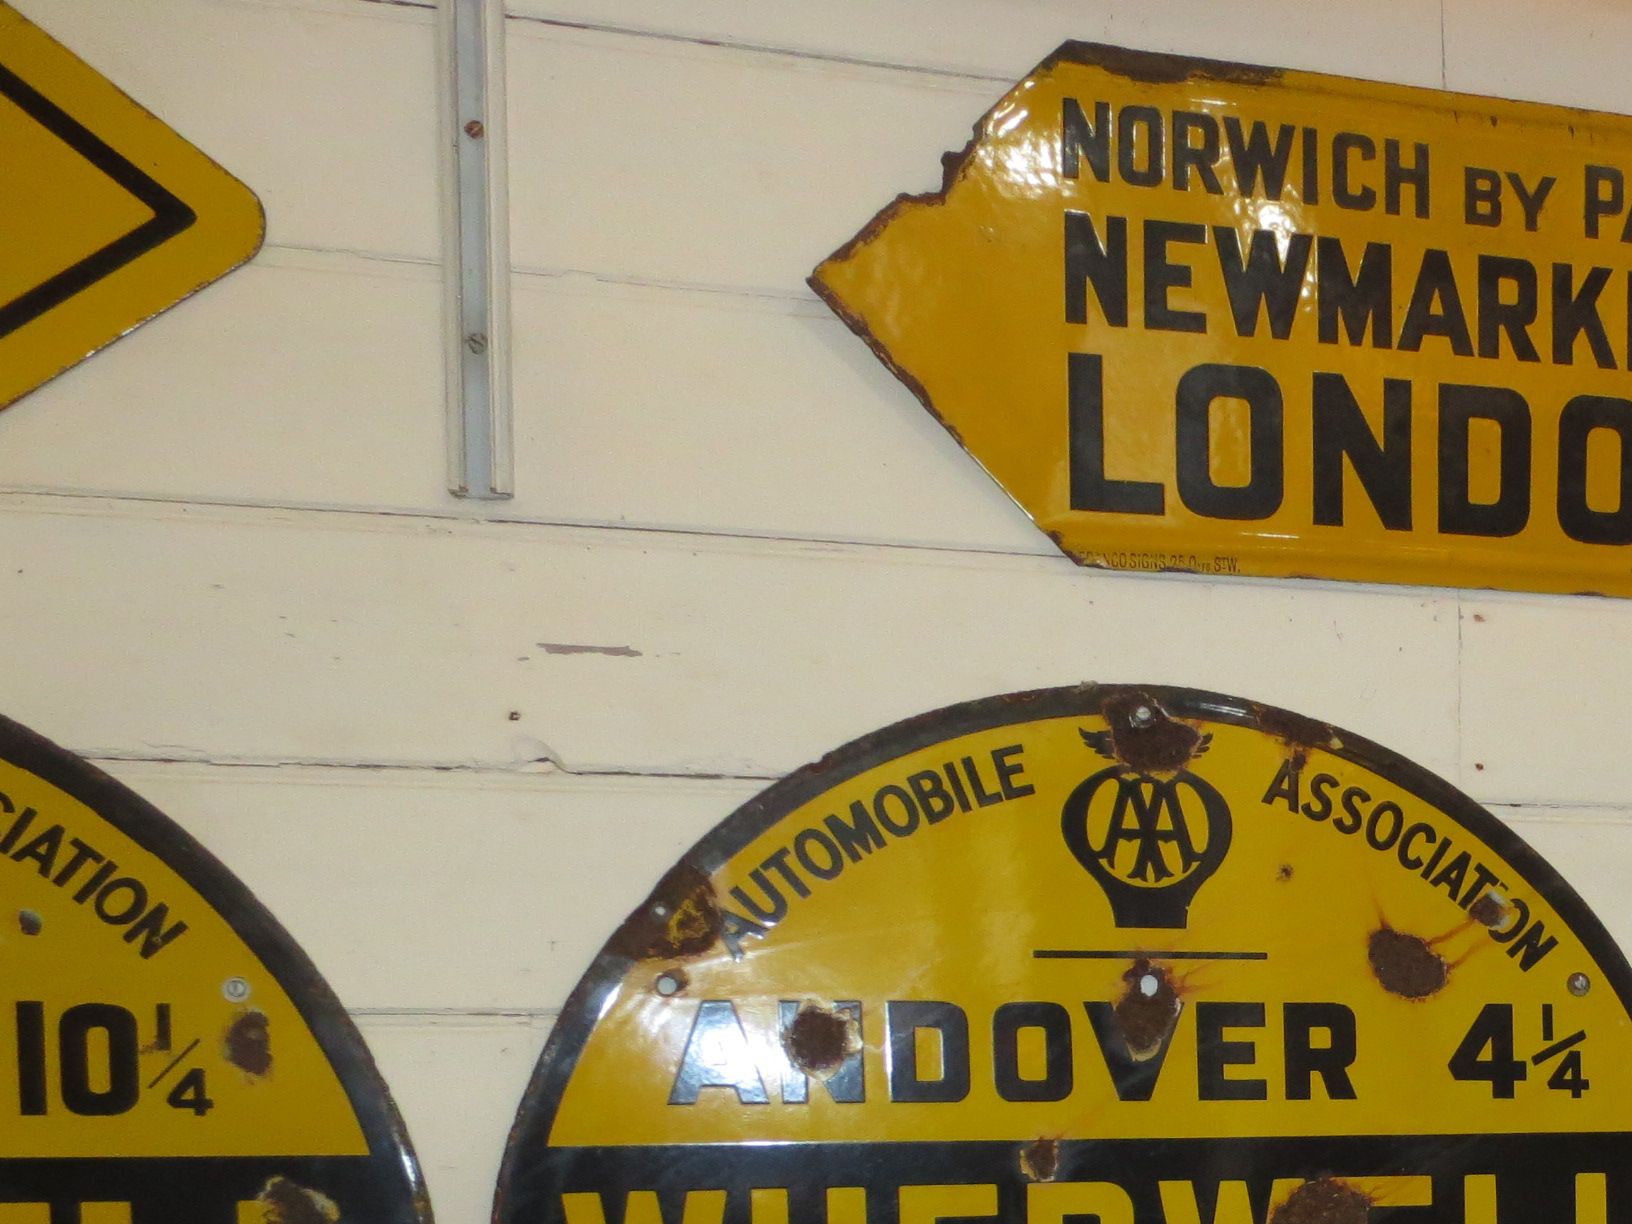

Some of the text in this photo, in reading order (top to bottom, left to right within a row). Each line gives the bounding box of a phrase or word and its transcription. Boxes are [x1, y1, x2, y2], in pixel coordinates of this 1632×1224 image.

[1063, 98, 1429, 220] NORWICH
[1464, 171, 1555, 232] BY
[0, 792, 188, 960] IATION
[719, 744, 1035, 962] AUTOMOBILE
[1261, 757, 1559, 972] ASSOCIATON
[670, 1000, 1358, 1104] ANDOVER
